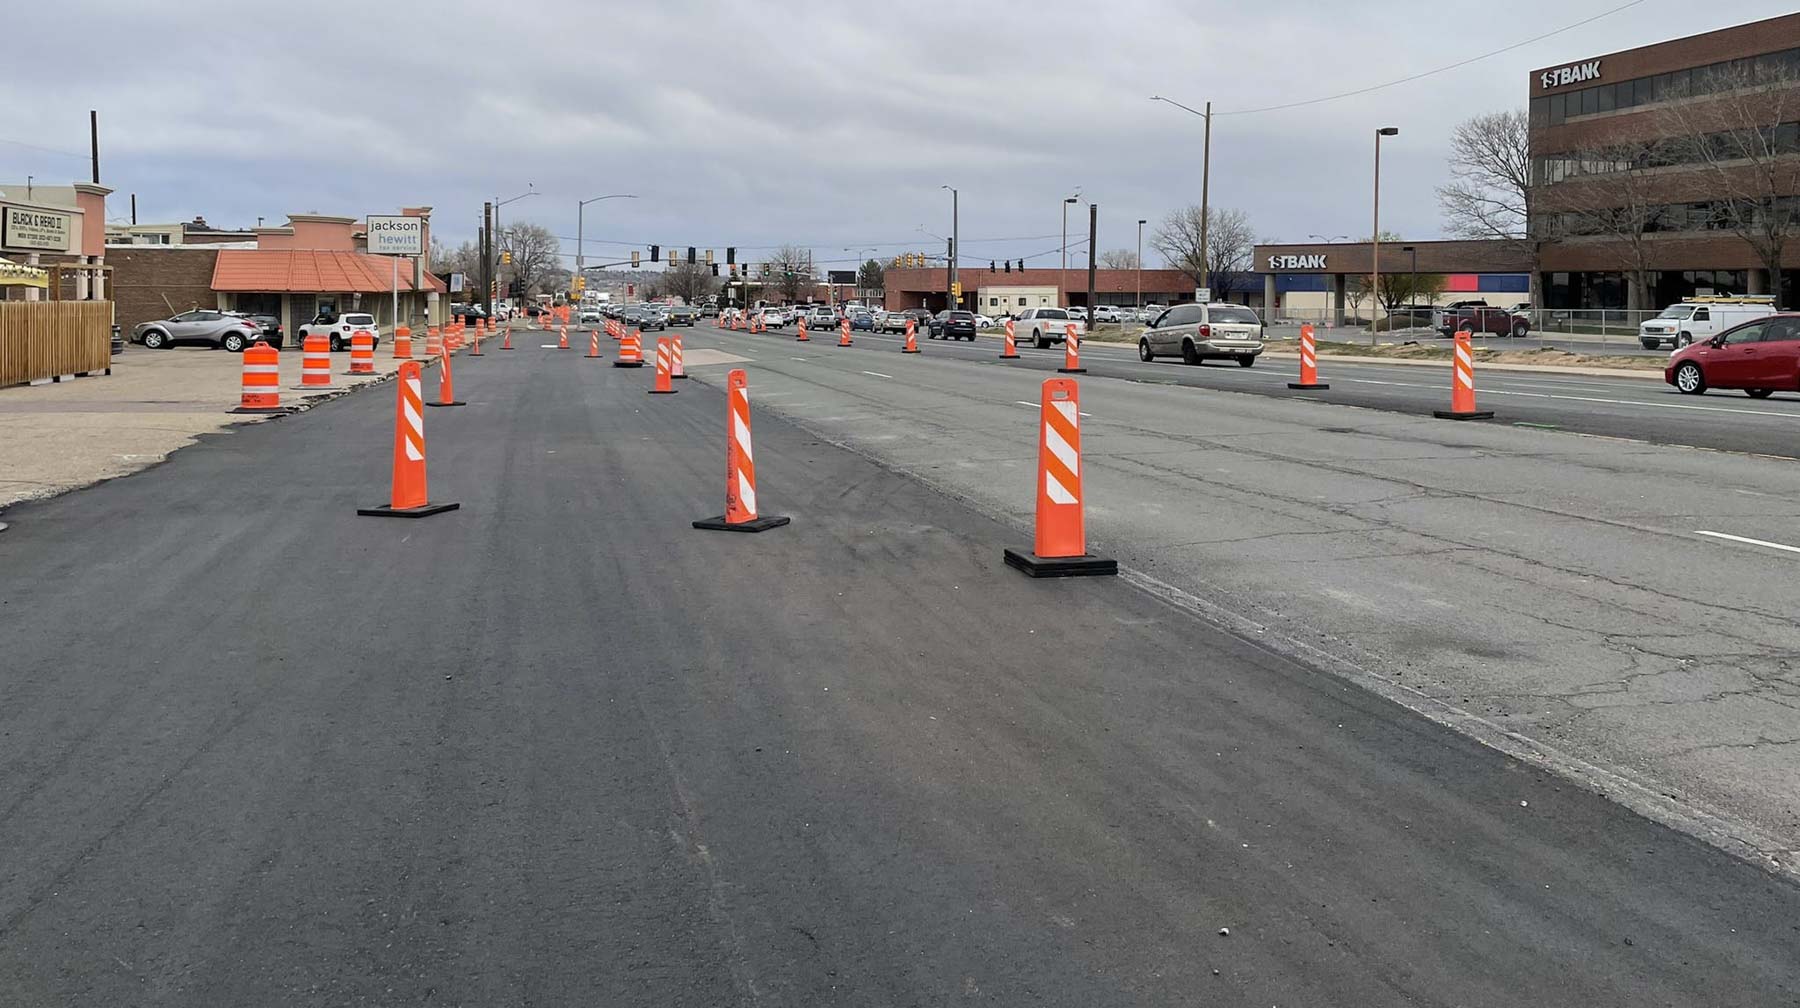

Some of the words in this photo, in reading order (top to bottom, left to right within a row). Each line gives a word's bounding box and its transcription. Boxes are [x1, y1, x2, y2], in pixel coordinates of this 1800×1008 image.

[13, 212, 33, 226] BLACK
[40, 216, 55, 228] READ
[371, 220, 418, 232] jackson
[379, 233, 416, 244] hewitt
